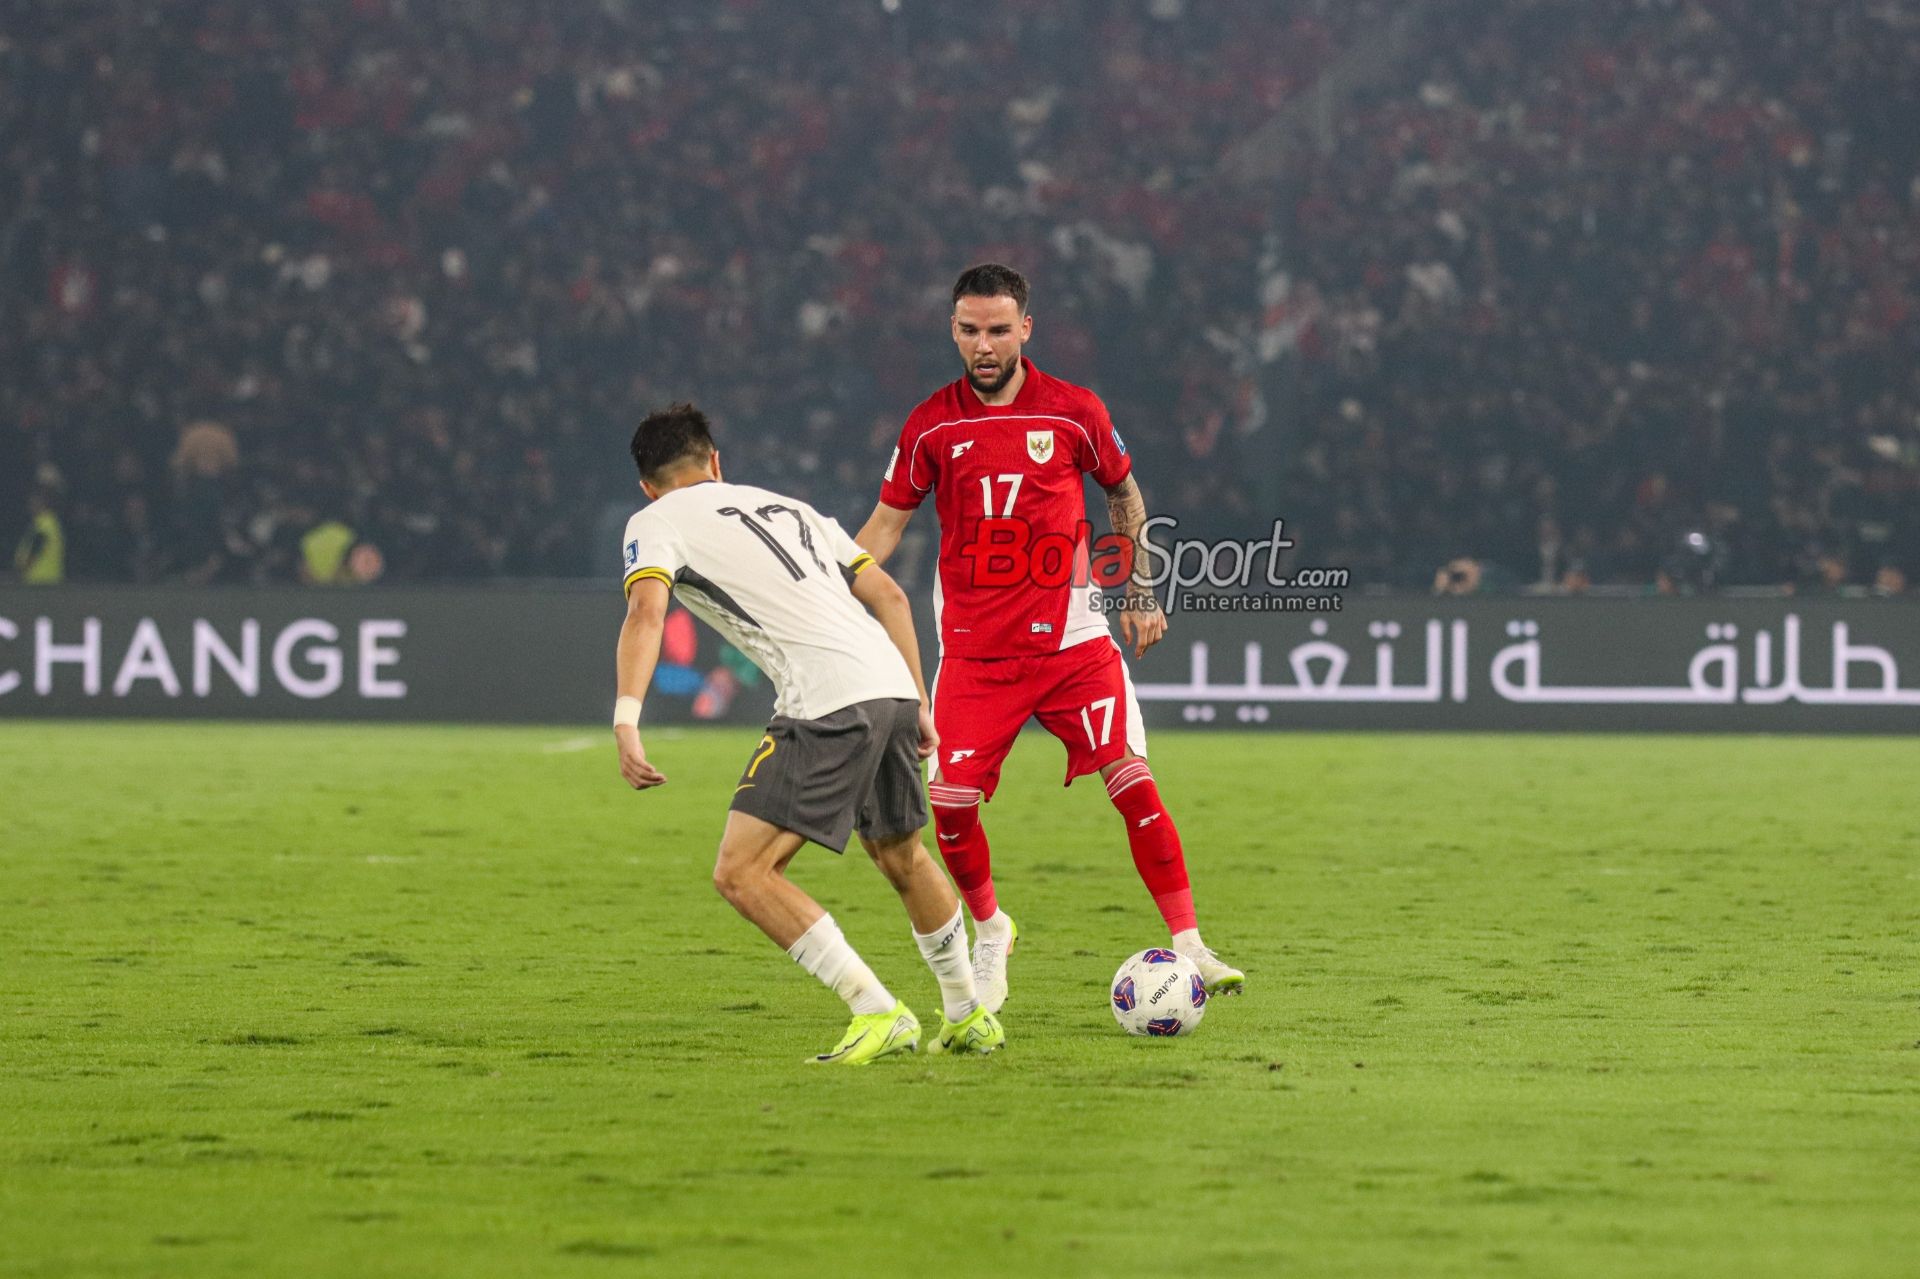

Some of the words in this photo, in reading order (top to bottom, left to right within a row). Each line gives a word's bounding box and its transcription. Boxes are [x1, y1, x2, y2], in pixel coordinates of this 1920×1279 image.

[979, 473, 1024, 520] 17
[716, 503, 831, 583] 17
[1134, 618, 1468, 722] التغيي
[1080, 696, 1116, 751] 17
[1149, 972, 1179, 1005] molten
